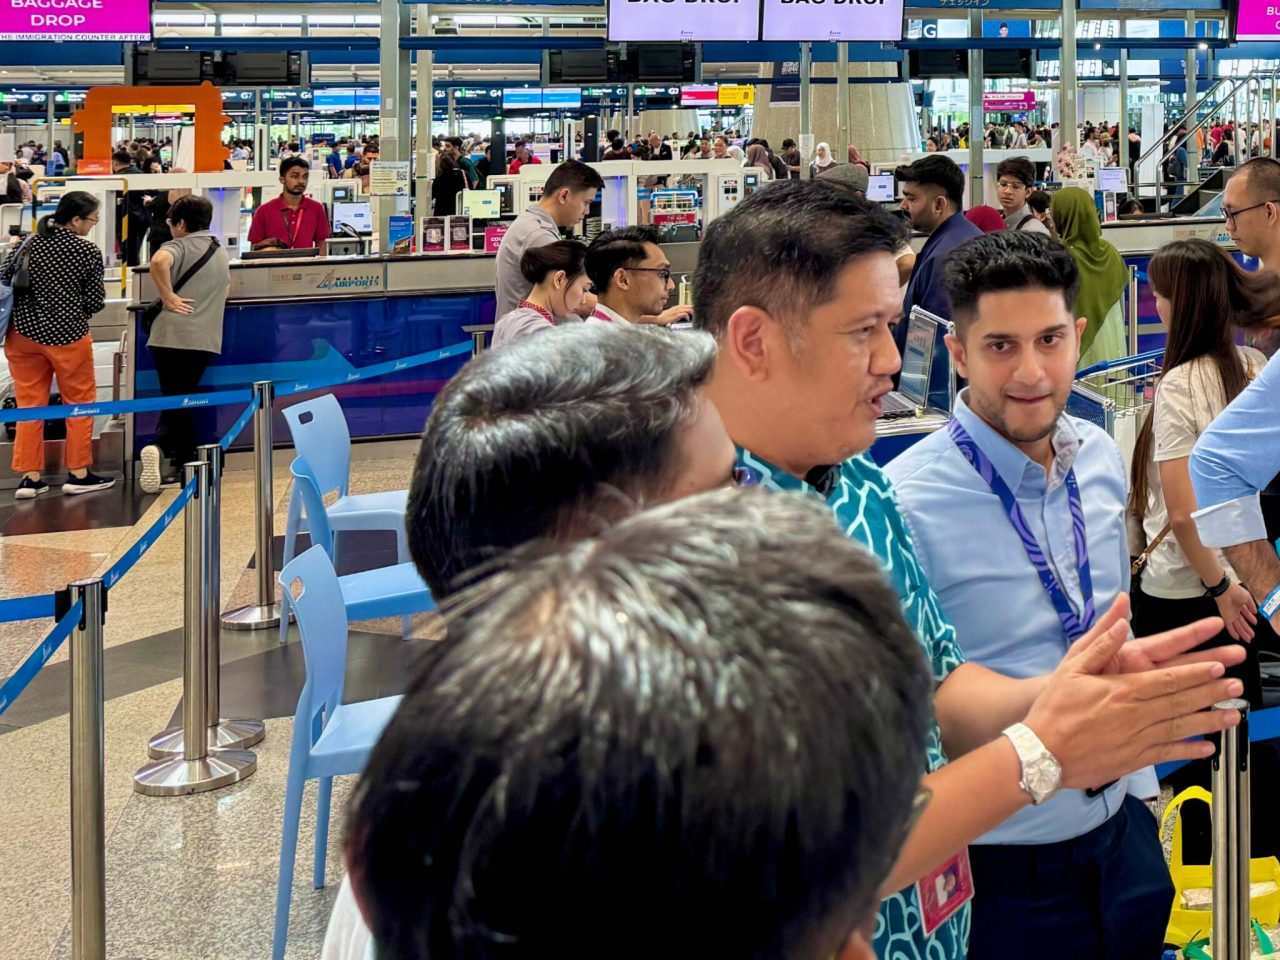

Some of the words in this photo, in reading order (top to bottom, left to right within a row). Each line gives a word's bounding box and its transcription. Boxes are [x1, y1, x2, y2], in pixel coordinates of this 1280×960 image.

[31, 14, 86, 27] DROP
[923, 24, 937, 38] G
[334, 279, 379, 288] AIRPORTS
